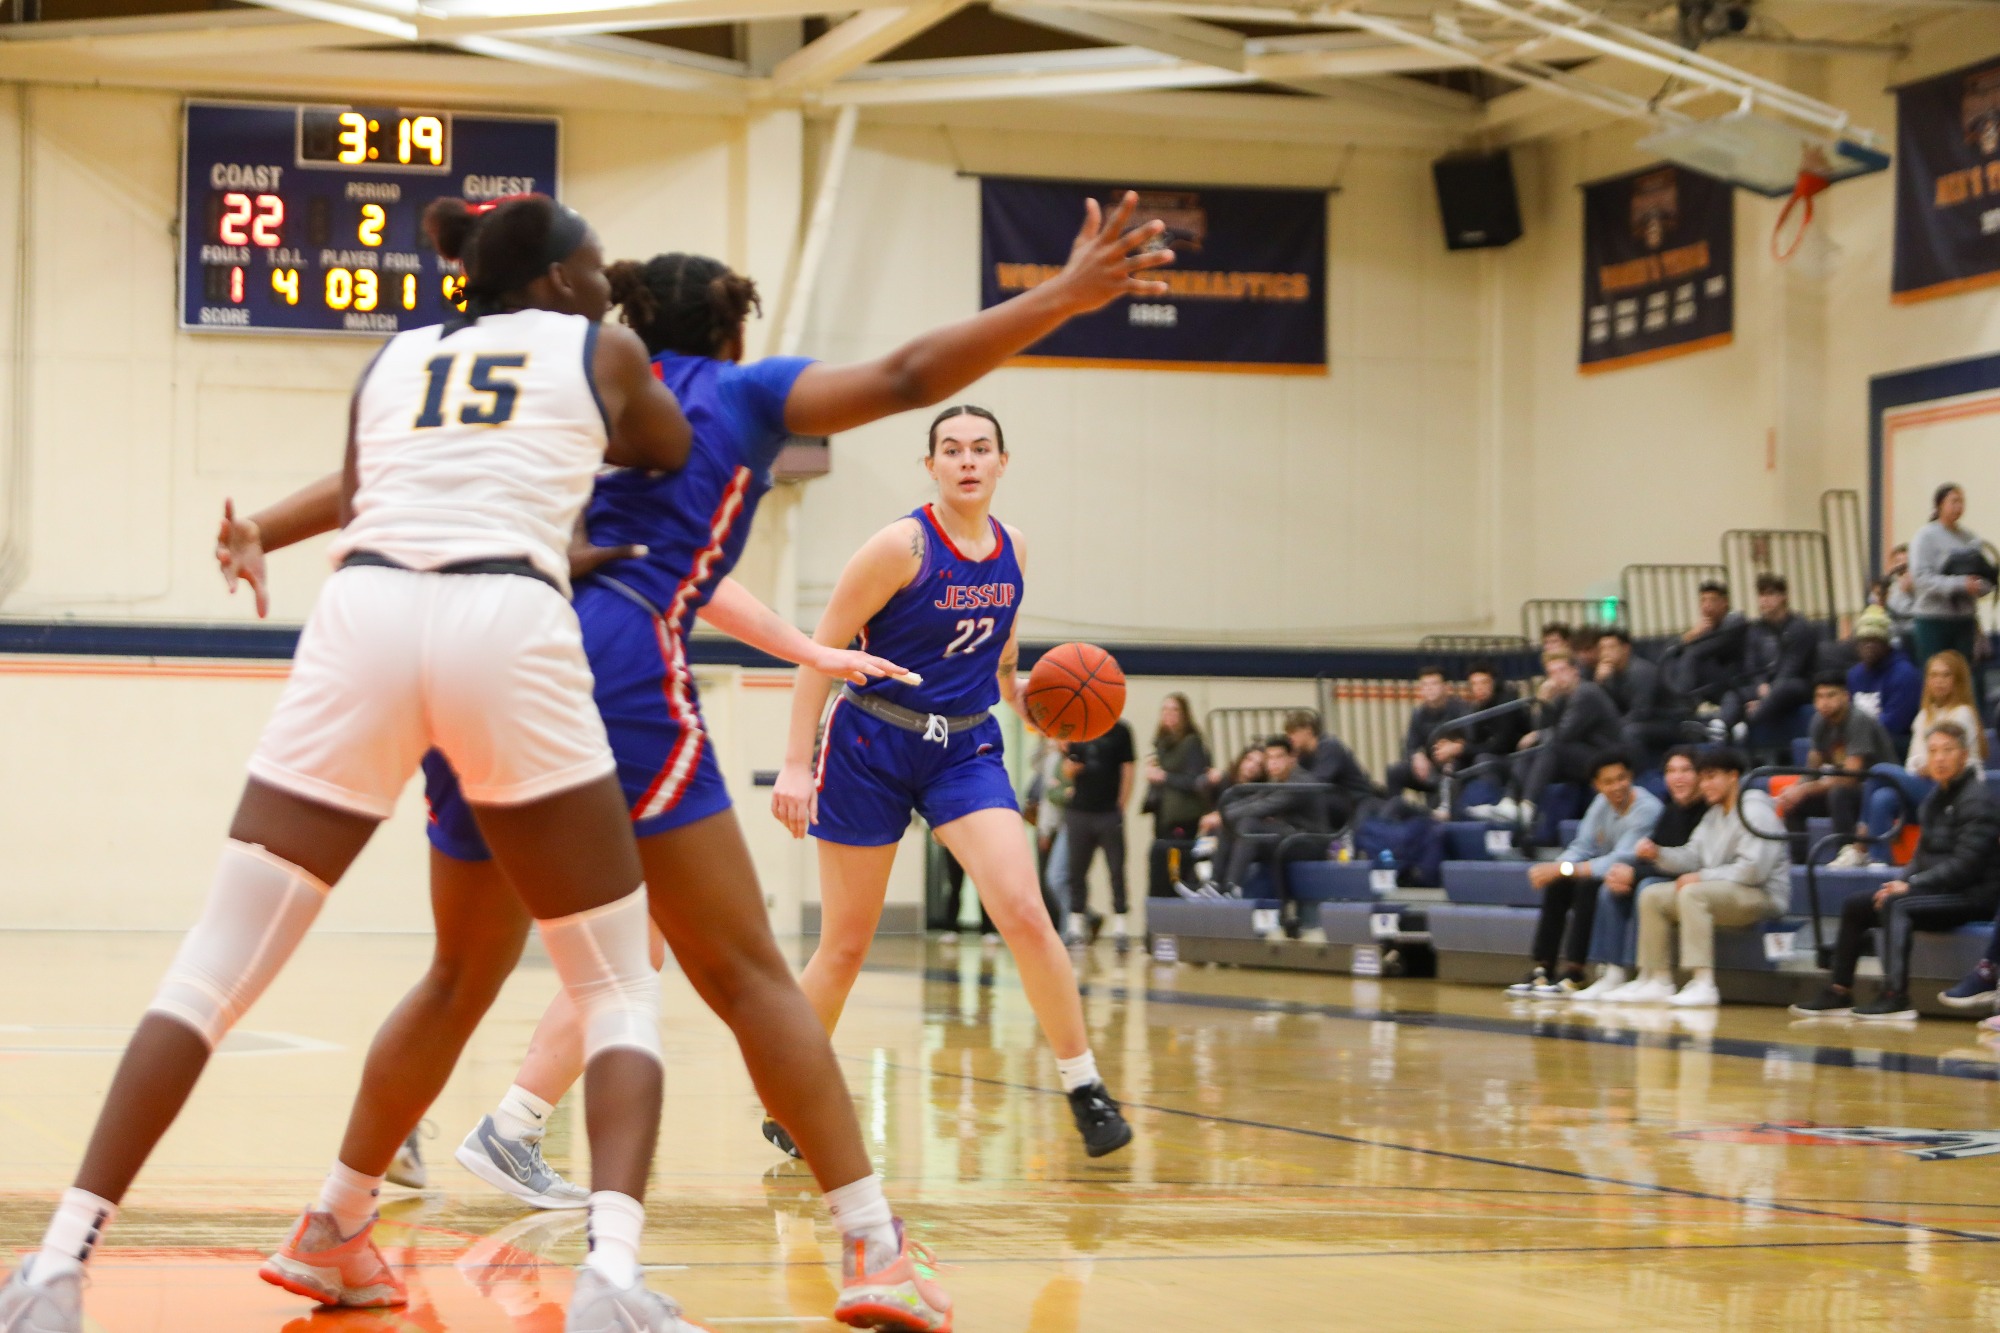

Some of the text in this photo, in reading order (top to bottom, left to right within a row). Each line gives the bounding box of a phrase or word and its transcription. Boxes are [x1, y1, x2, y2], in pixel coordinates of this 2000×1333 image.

[337, 112, 443, 166] 3:19
[210, 162, 283, 192] COAST
[345, 182, 401, 203] PERIOD
[462, 174, 535, 200] GUEST
[220, 192, 284, 247] 22
[358, 203, 386, 247] 2
[200, 244, 251, 265] FOULS
[320, 248, 379, 269] PLAYER
[230, 266, 245, 303] 1
[271, 268, 299, 305] 4
[325, 267, 378, 311] 03
[402, 273, 416, 311] 1
[199, 306, 251, 325] SCORE
[343, 312, 399, 331] MATCH
[412, 351, 531, 429] 15
[934, 582, 1016, 609] JESSUP
[941, 616, 995, 659] 22
